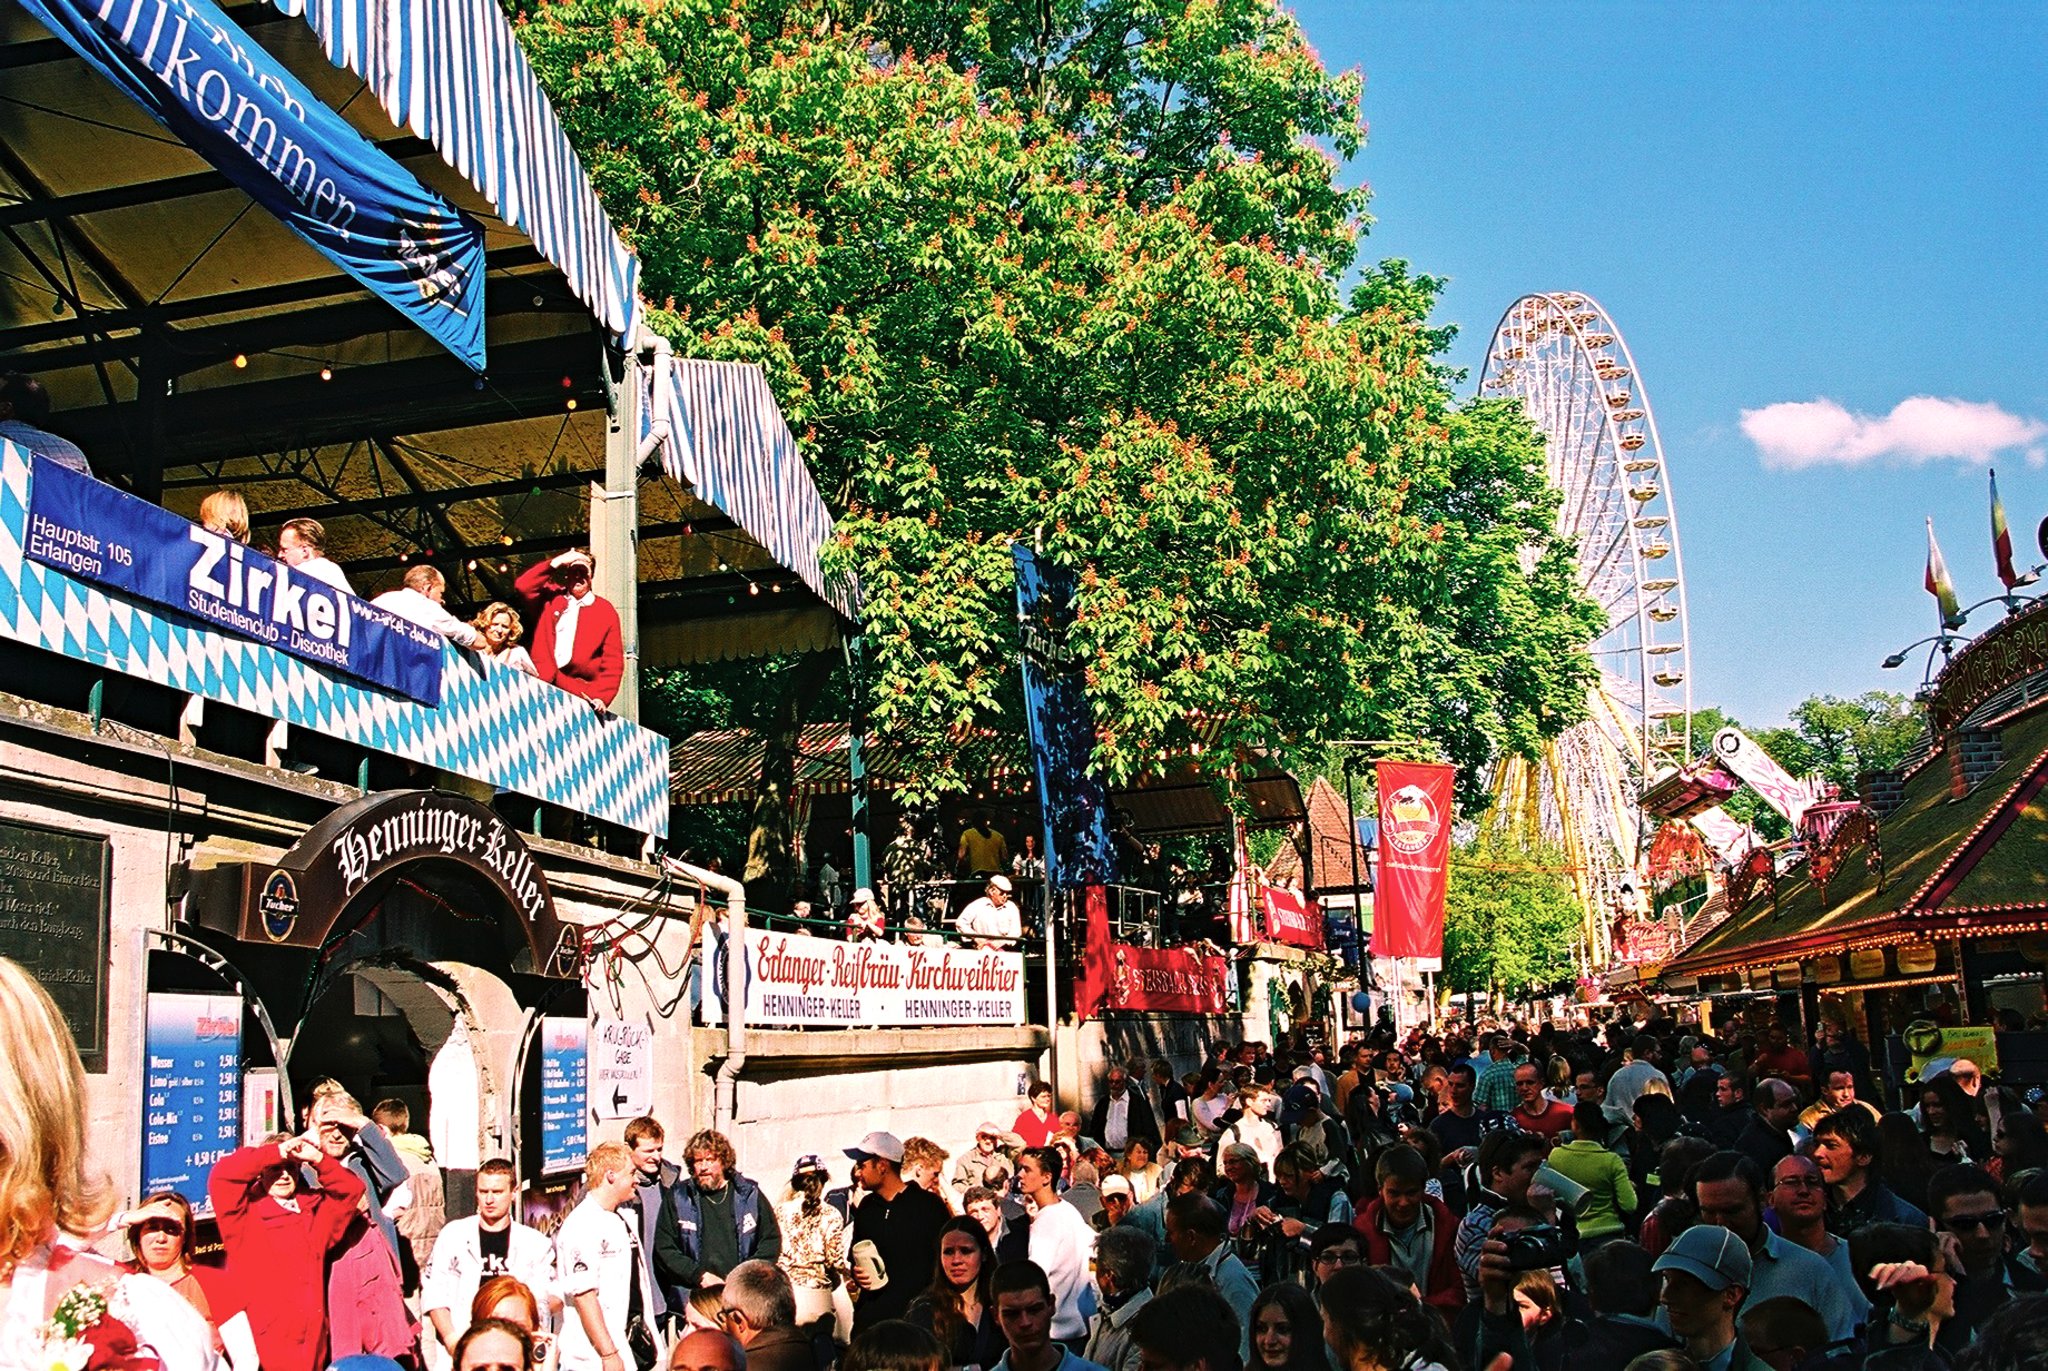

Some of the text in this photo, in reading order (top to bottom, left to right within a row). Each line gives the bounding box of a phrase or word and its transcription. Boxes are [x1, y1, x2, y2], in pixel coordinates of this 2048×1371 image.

[32, 514, 133, 566] Hauptstr. 105
[30, 533, 102, 575] Erlangen
[189, 524, 351, 647] Zirkel
[188, 589, 279, 643] Studentenclub
[290, 632, 350, 666] Discothek
[333, 797, 545, 922] Henninger-Keller
[264, 897, 295, 912] Tucher
[757, 935, 826, 995] Erlanger
[906, 950, 1019, 993] Kirchweihbier
[763, 994, 1012, 1019] HENNINGER-KELLER HENNINGER-KELLER
[196, 1017, 239, 1036] Zirkel
[150, 1055, 174, 1068] Wasser
[219, 1055, 233, 1068] 2,50
[219, 1072, 233, 1086] 2,50
[219, 1090, 233, 1104] 2,50
[219, 1108, 233, 1122] 2,50
[218, 1125, 232, 1139] 2,50
[194, 1152, 210, 1167] 0,50
